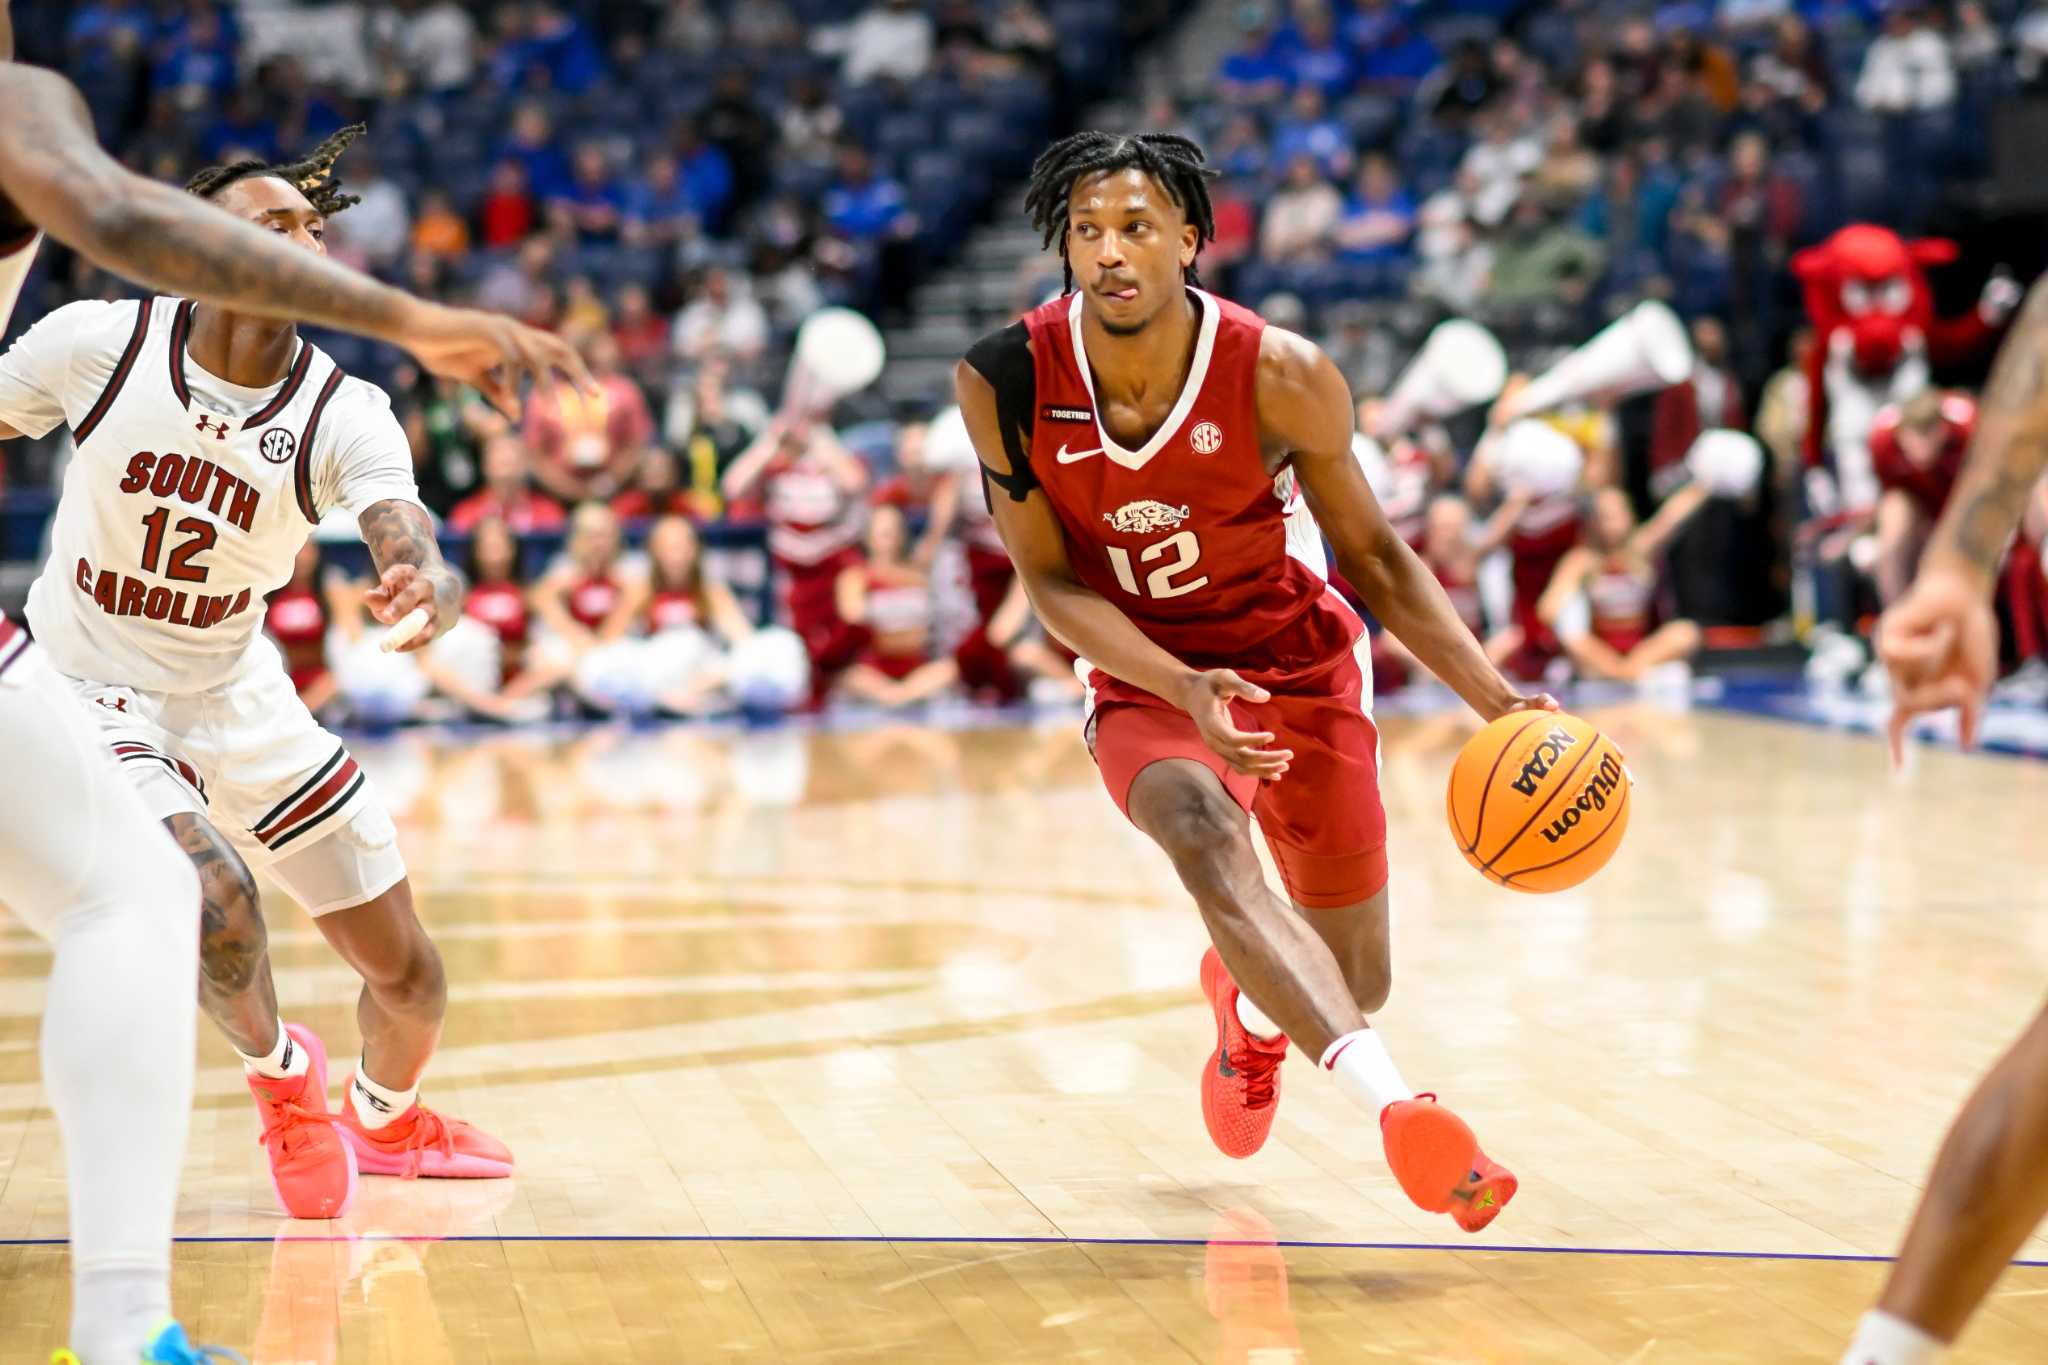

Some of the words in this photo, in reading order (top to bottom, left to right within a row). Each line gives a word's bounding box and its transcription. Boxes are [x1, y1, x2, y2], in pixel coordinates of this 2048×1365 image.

[262, 429, 294, 461] SEC
[1051, 409, 1091, 421] TOGETHER
[1192, 424, 1221, 452] SEC
[119, 451, 261, 533] SOUTH
[141, 506, 218, 584] 12
[1106, 530, 1209, 599] 12
[76, 557, 251, 629] CAROLINA
[1511, 727, 1577, 797] NCAA
[1540, 752, 1622, 843] Wilson
